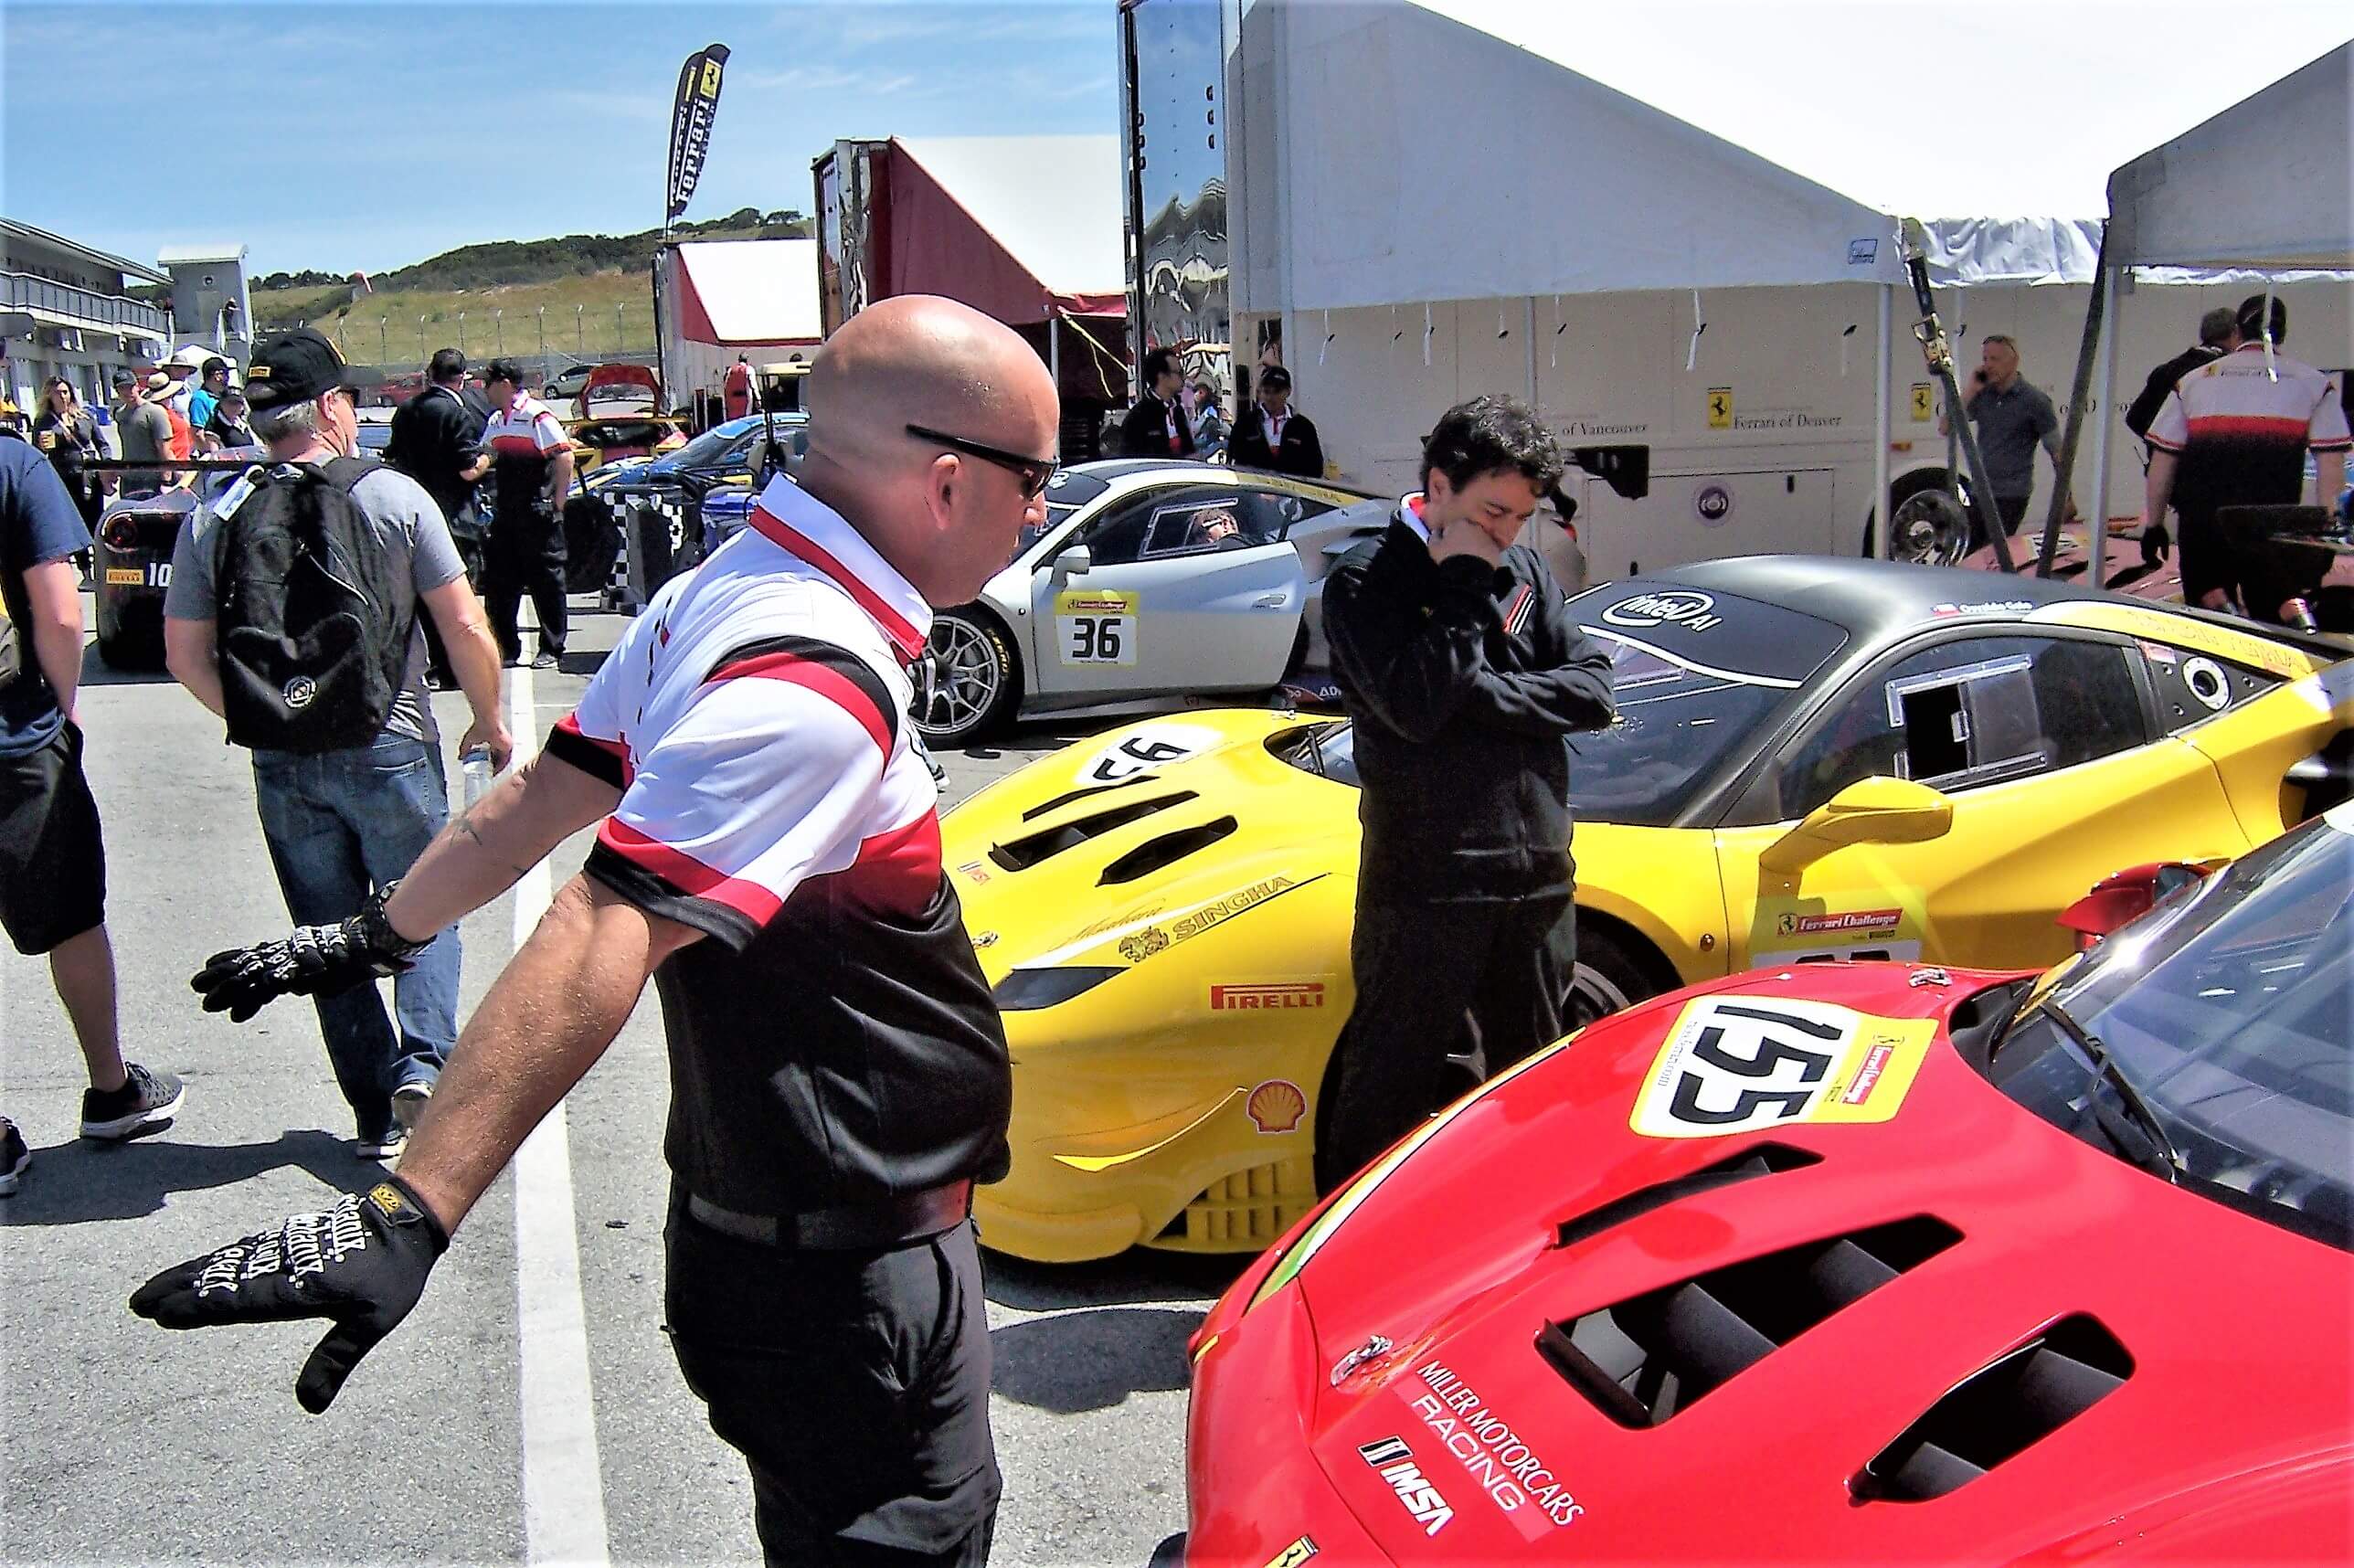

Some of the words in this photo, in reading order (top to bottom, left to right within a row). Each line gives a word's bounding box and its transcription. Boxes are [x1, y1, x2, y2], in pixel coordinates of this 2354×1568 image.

[675, 99, 710, 202] Ferrari
[1579, 422, 1648, 436] Vancouver
[1072, 618, 1122, 659] 36
[1172, 875, 1295, 941] SINGHA
[1800, 916, 1843, 930] Ferrari
[1843, 912, 1897, 927] Challenge
[1210, 983, 1325, 1010] PIRELLI
[1670, 1004, 1843, 1125] 155
[1410, 1393, 1526, 1512] RACING
[1416, 1360, 1480, 1416] MILLER
[1464, 1407, 1585, 1527] MOTORCARS
[1380, 1462, 1455, 1538] IMSA
